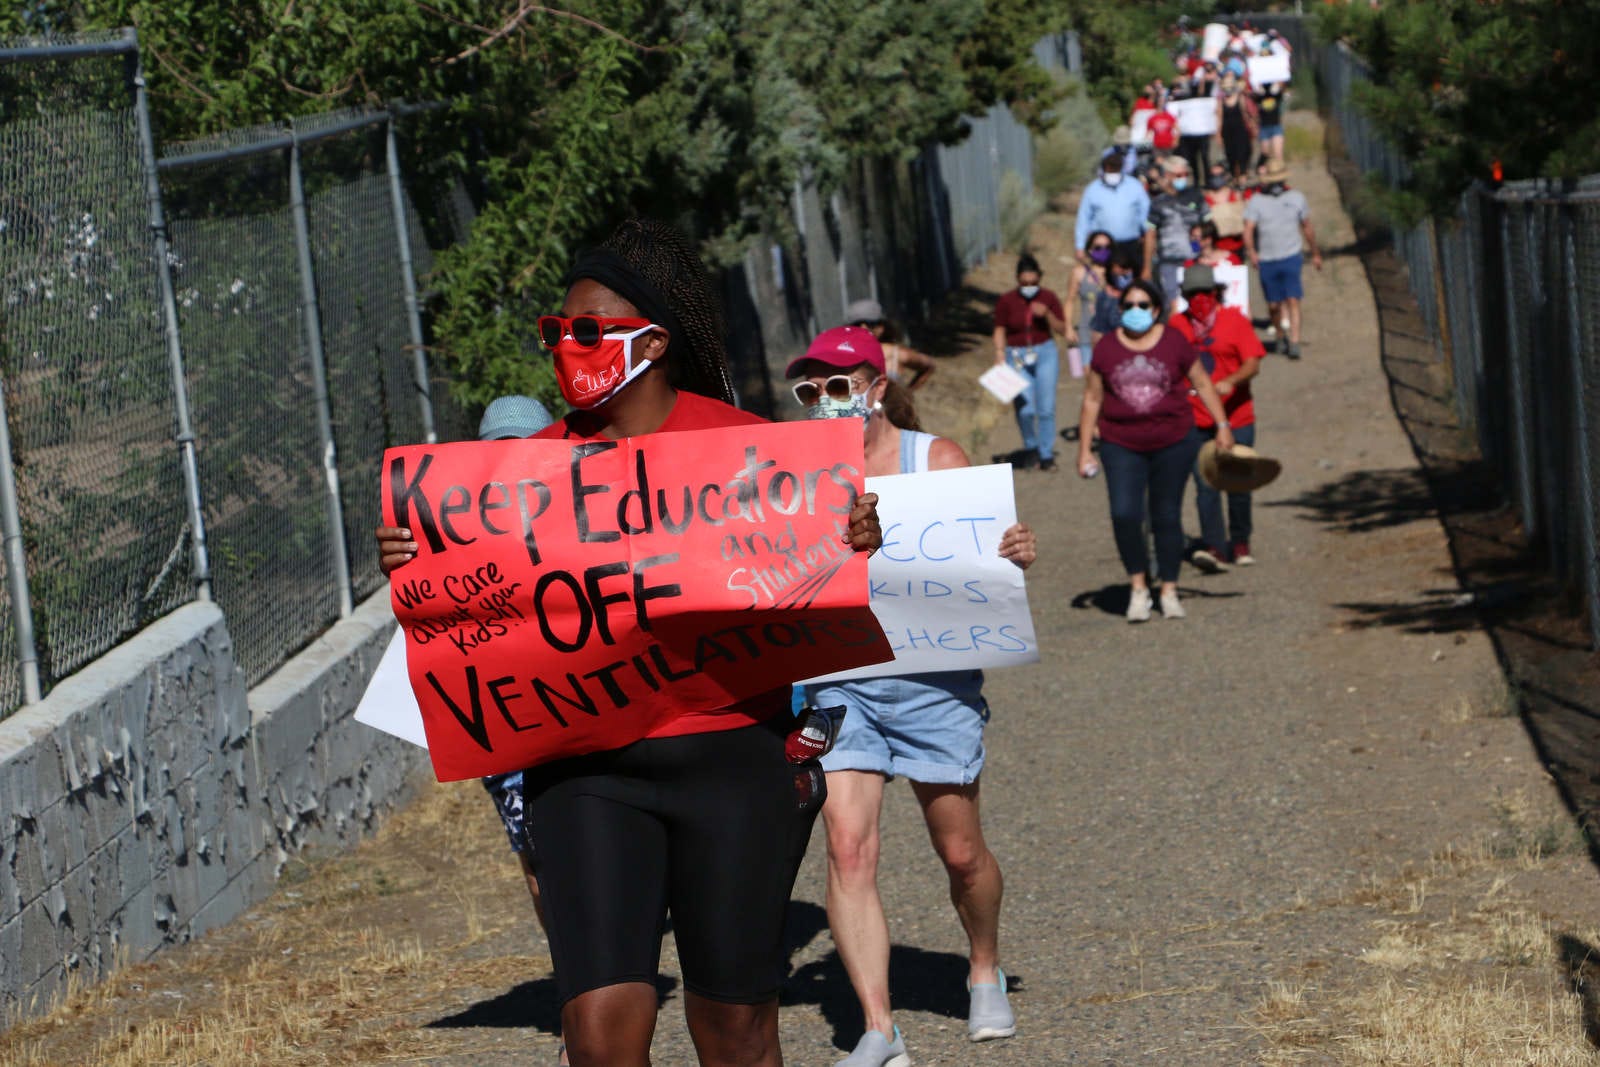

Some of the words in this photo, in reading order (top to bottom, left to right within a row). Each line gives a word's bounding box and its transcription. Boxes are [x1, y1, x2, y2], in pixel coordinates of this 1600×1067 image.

[391, 454, 552, 566] Keep
[571, 441, 858, 542] Educators
[721, 521, 798, 561] and
[395, 579, 436, 610] We
[443, 562, 504, 604] Care
[412, 605, 474, 644] about
[479, 583, 522, 618] your
[533, 553, 681, 653] OFF
[870, 580, 988, 603] KIDS
[425, 618, 878, 753] VENTILATORS
